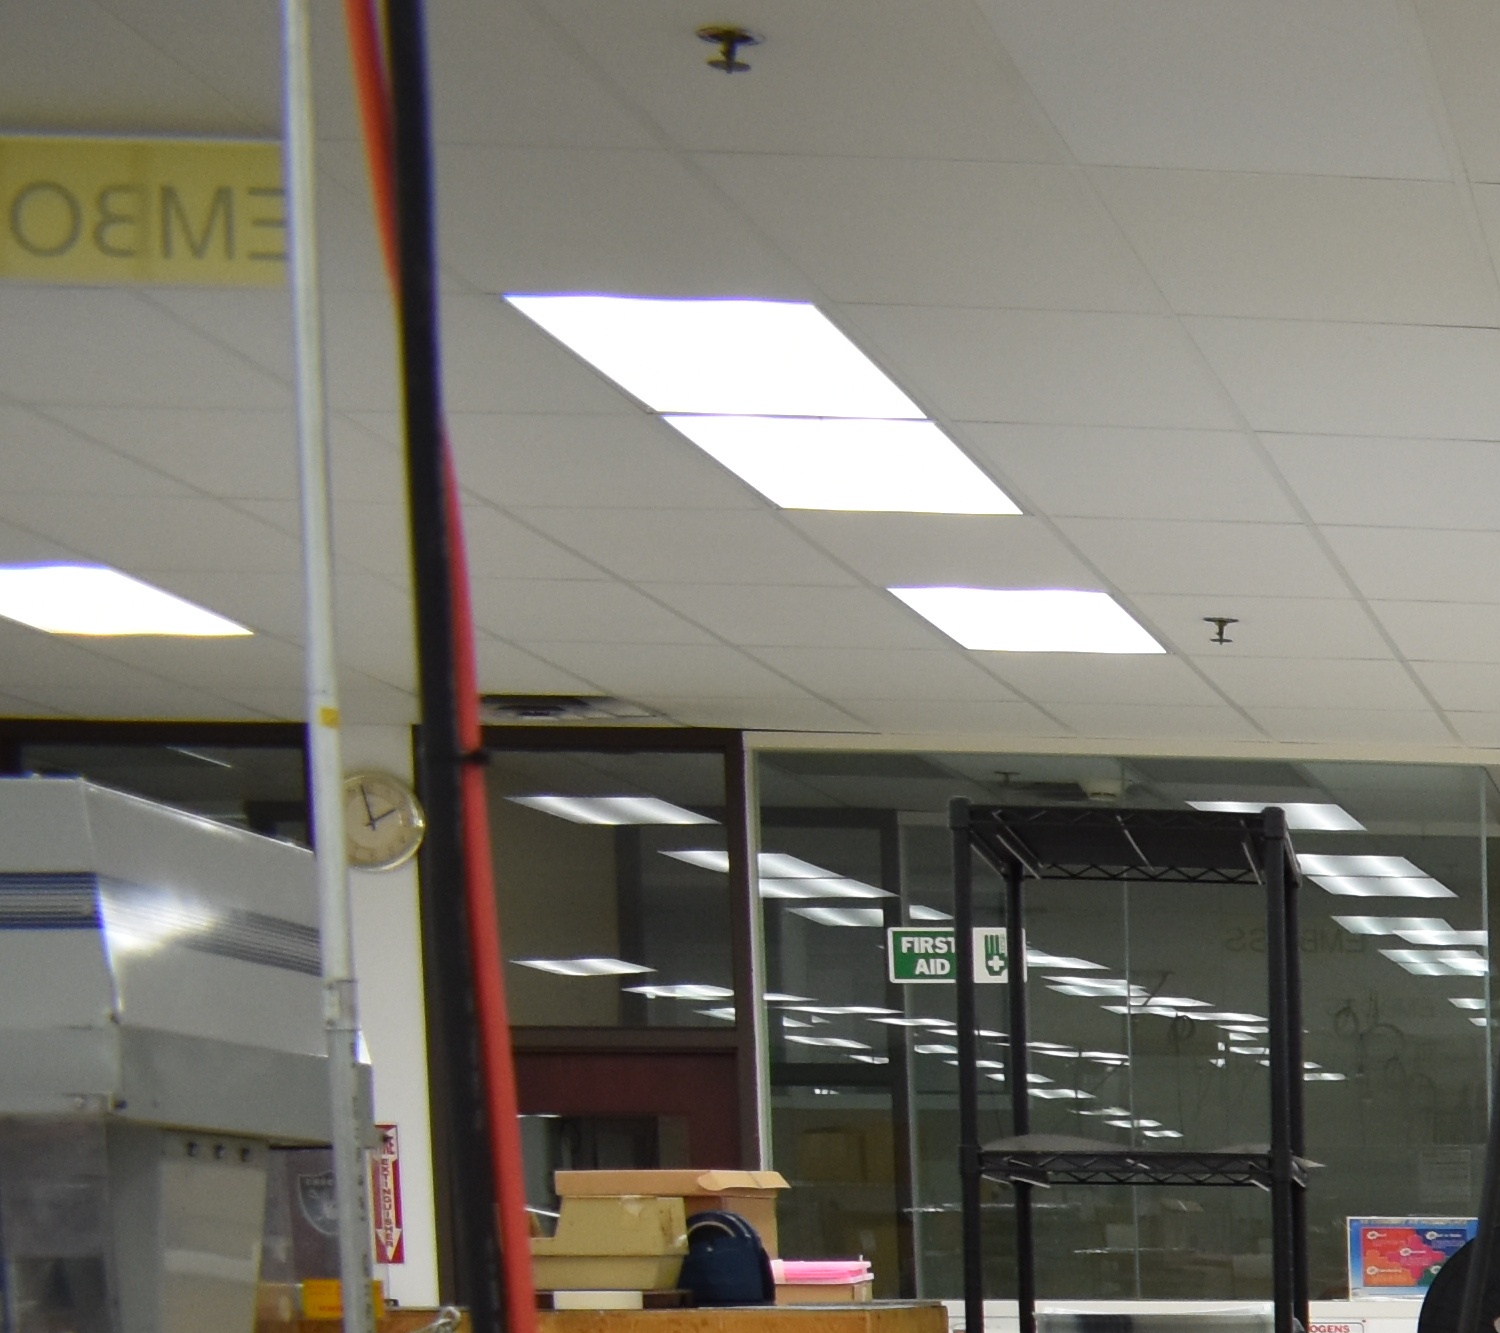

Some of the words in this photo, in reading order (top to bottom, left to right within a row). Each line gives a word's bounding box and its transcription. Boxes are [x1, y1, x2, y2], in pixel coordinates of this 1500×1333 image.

[902, 936, 956, 954] FIRST
[915, 958, 950, 975] AID
[380, 1158, 395, 1248] EXTINGUISHER
[1310, 1325, 1350, 1333] OGENS
